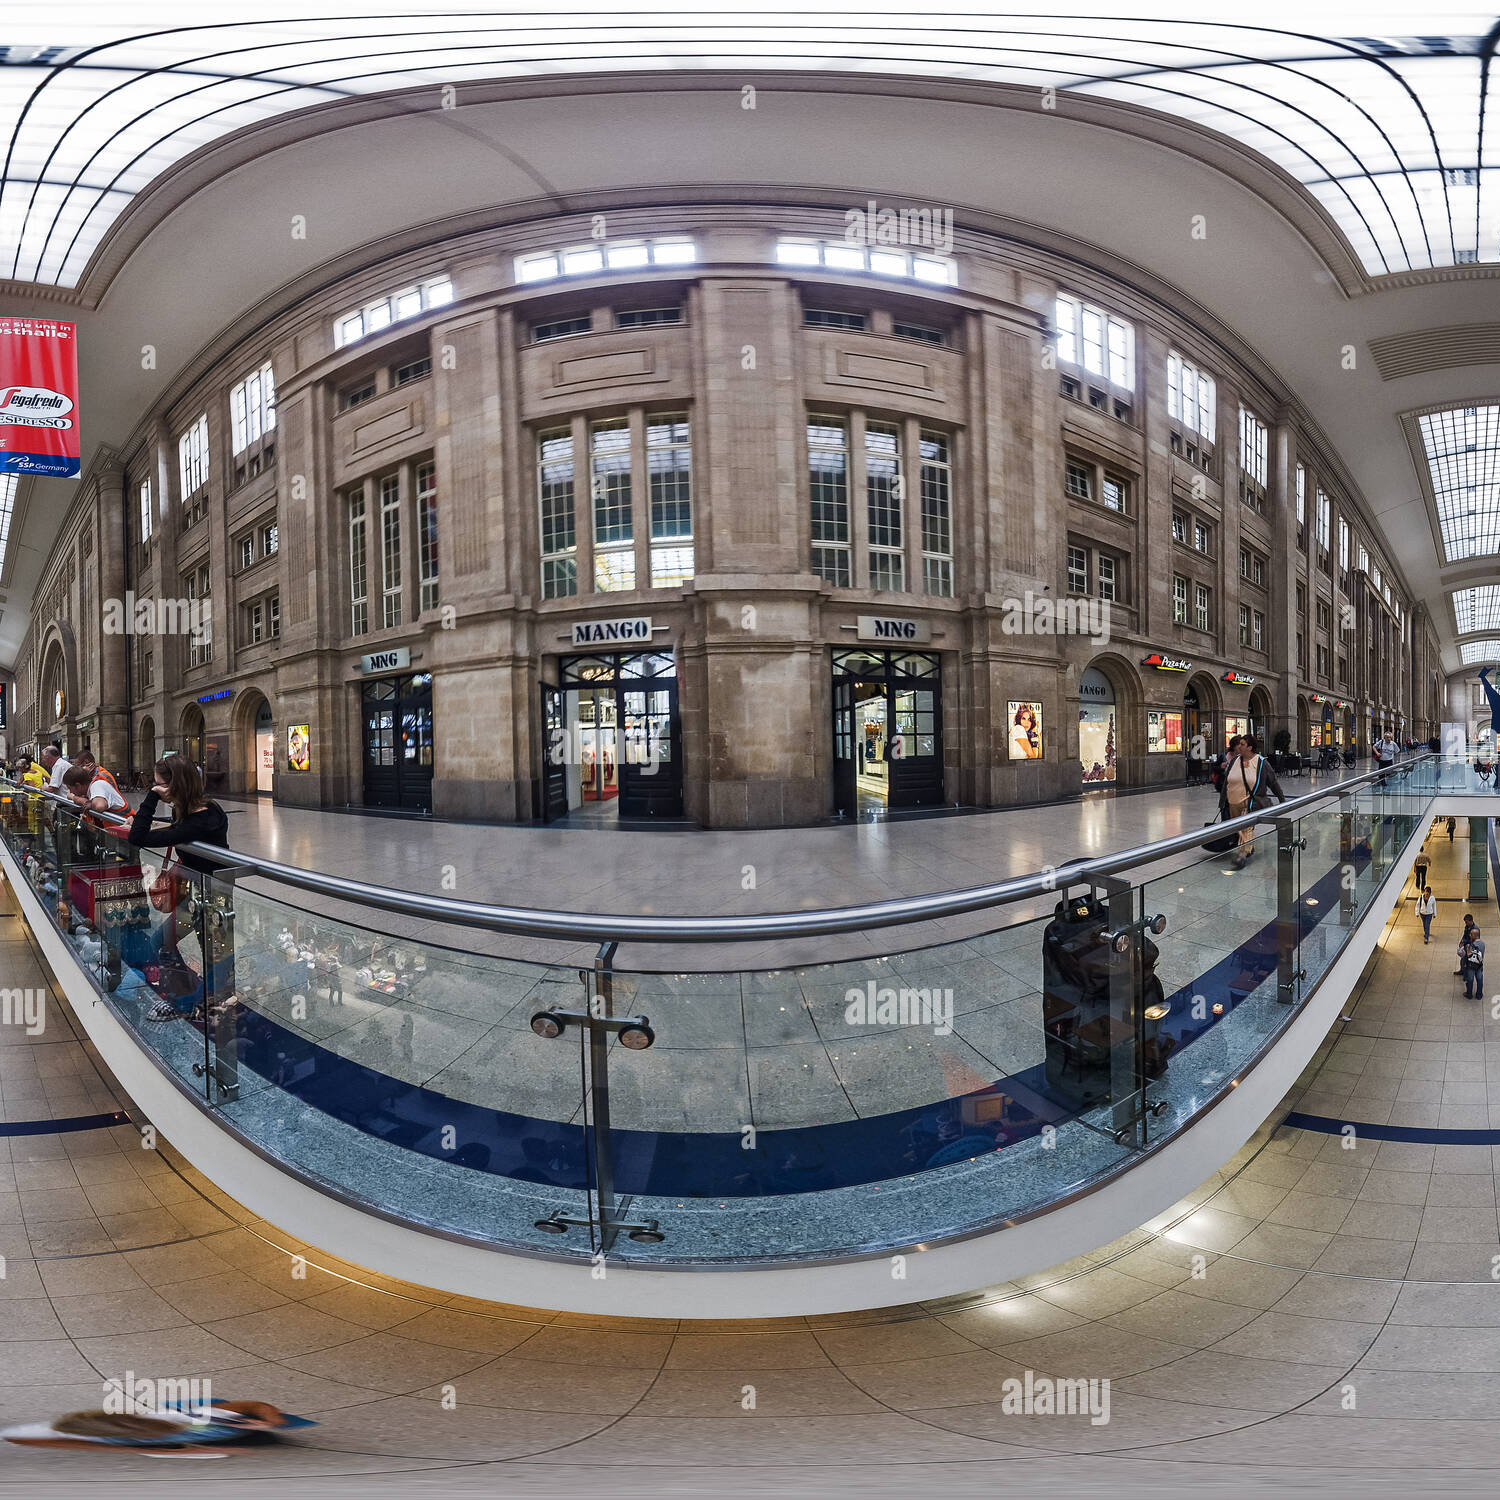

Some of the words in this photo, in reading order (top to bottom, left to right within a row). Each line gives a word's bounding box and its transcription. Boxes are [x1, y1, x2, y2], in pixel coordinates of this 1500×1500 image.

[0, 389, 64, 409] Segafredo
[35, 463, 70, 473] Germany
[575, 620, 648, 643] MANGO
[875, 620, 916, 639] MNG
[370, 652, 398, 671] MNG
[1161, 656, 1179, 668] Pizza
[1178, 660, 1192, 670] Hut
